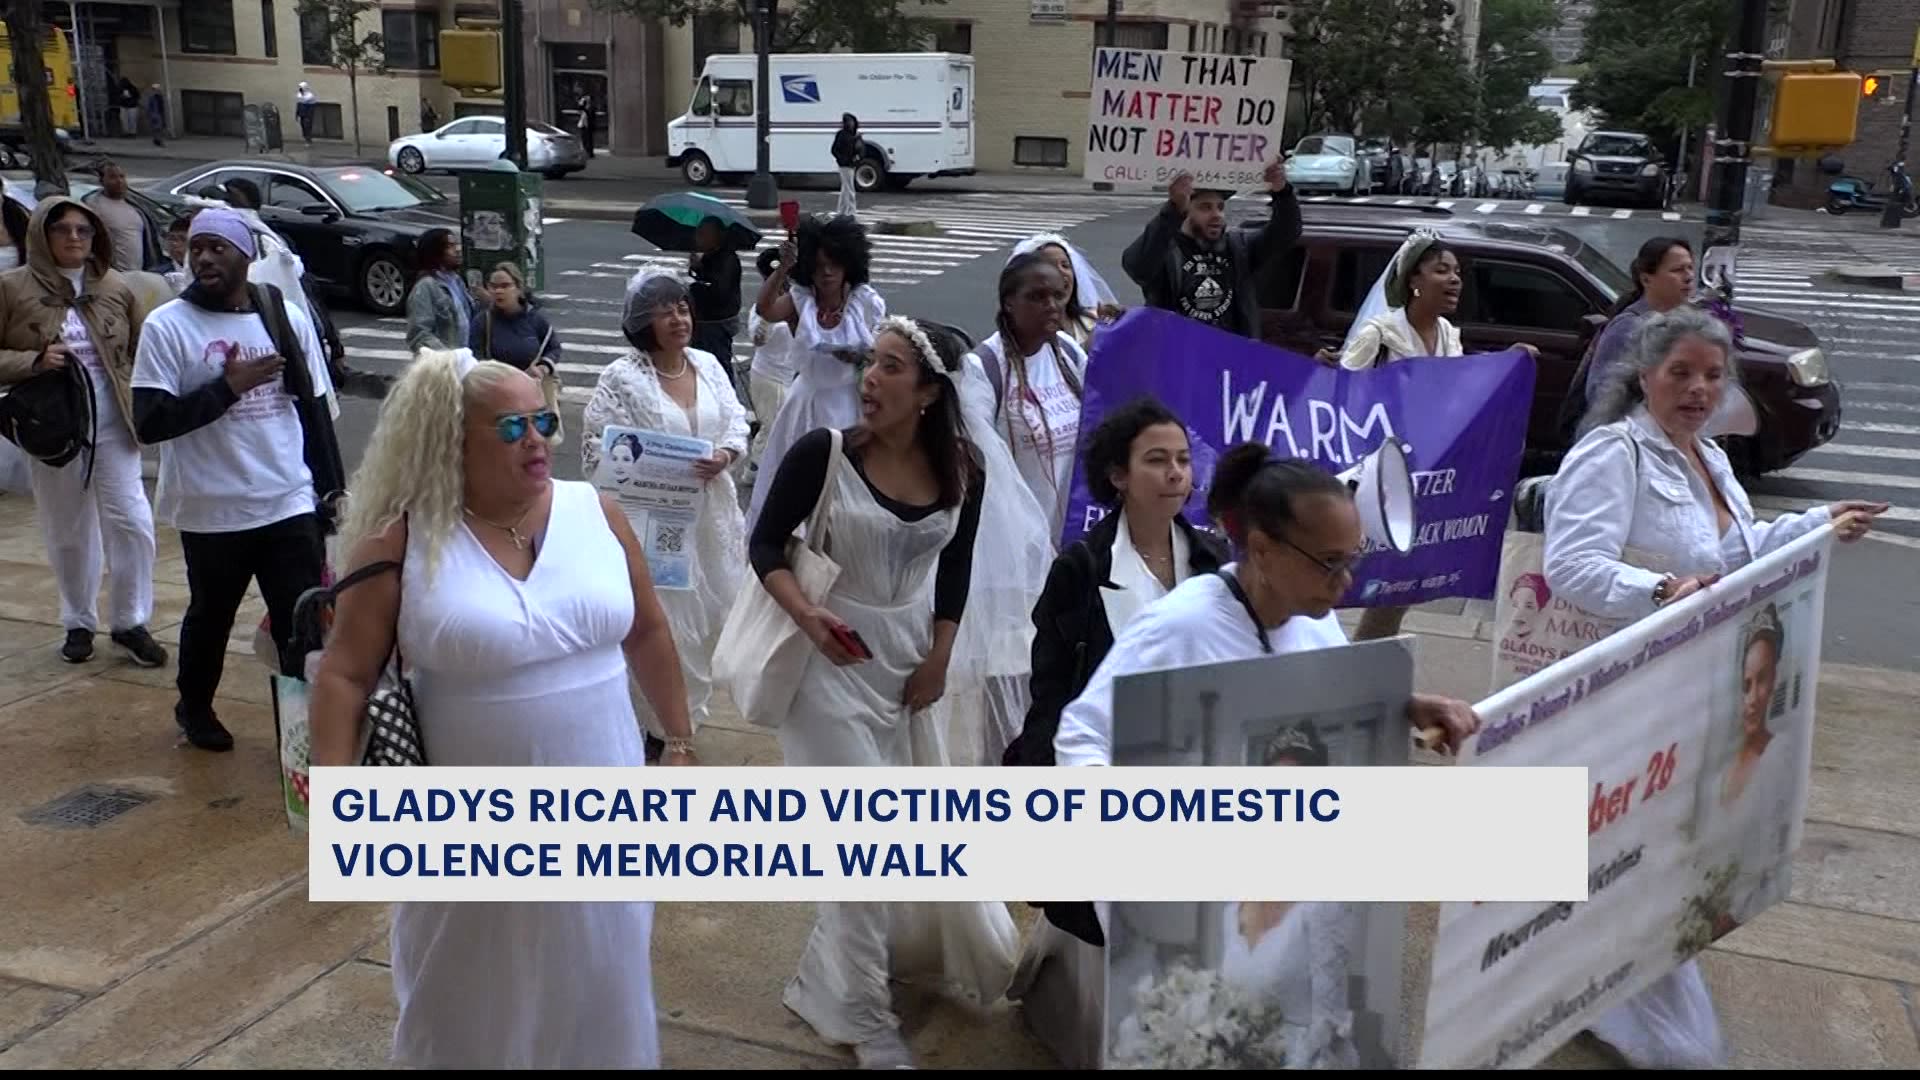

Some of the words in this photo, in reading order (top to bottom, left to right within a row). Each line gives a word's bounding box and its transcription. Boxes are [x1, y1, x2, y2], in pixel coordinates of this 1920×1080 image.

[1097, 50, 1162, 82] MEN
[1181, 55, 1257, 86] THAT
[1102, 89, 1223, 125] MATTER
[1236, 97, 1275, 126] DO
[1089, 124, 1147, 154] NOT
[1155, 129, 1267, 162] BATTER
[1104, 165, 1147, 181] CALL:
[1501, 637, 1556, 660] GLADYS
[1588, 778, 1637, 837] ber
[1642, 742, 1678, 802] 26
